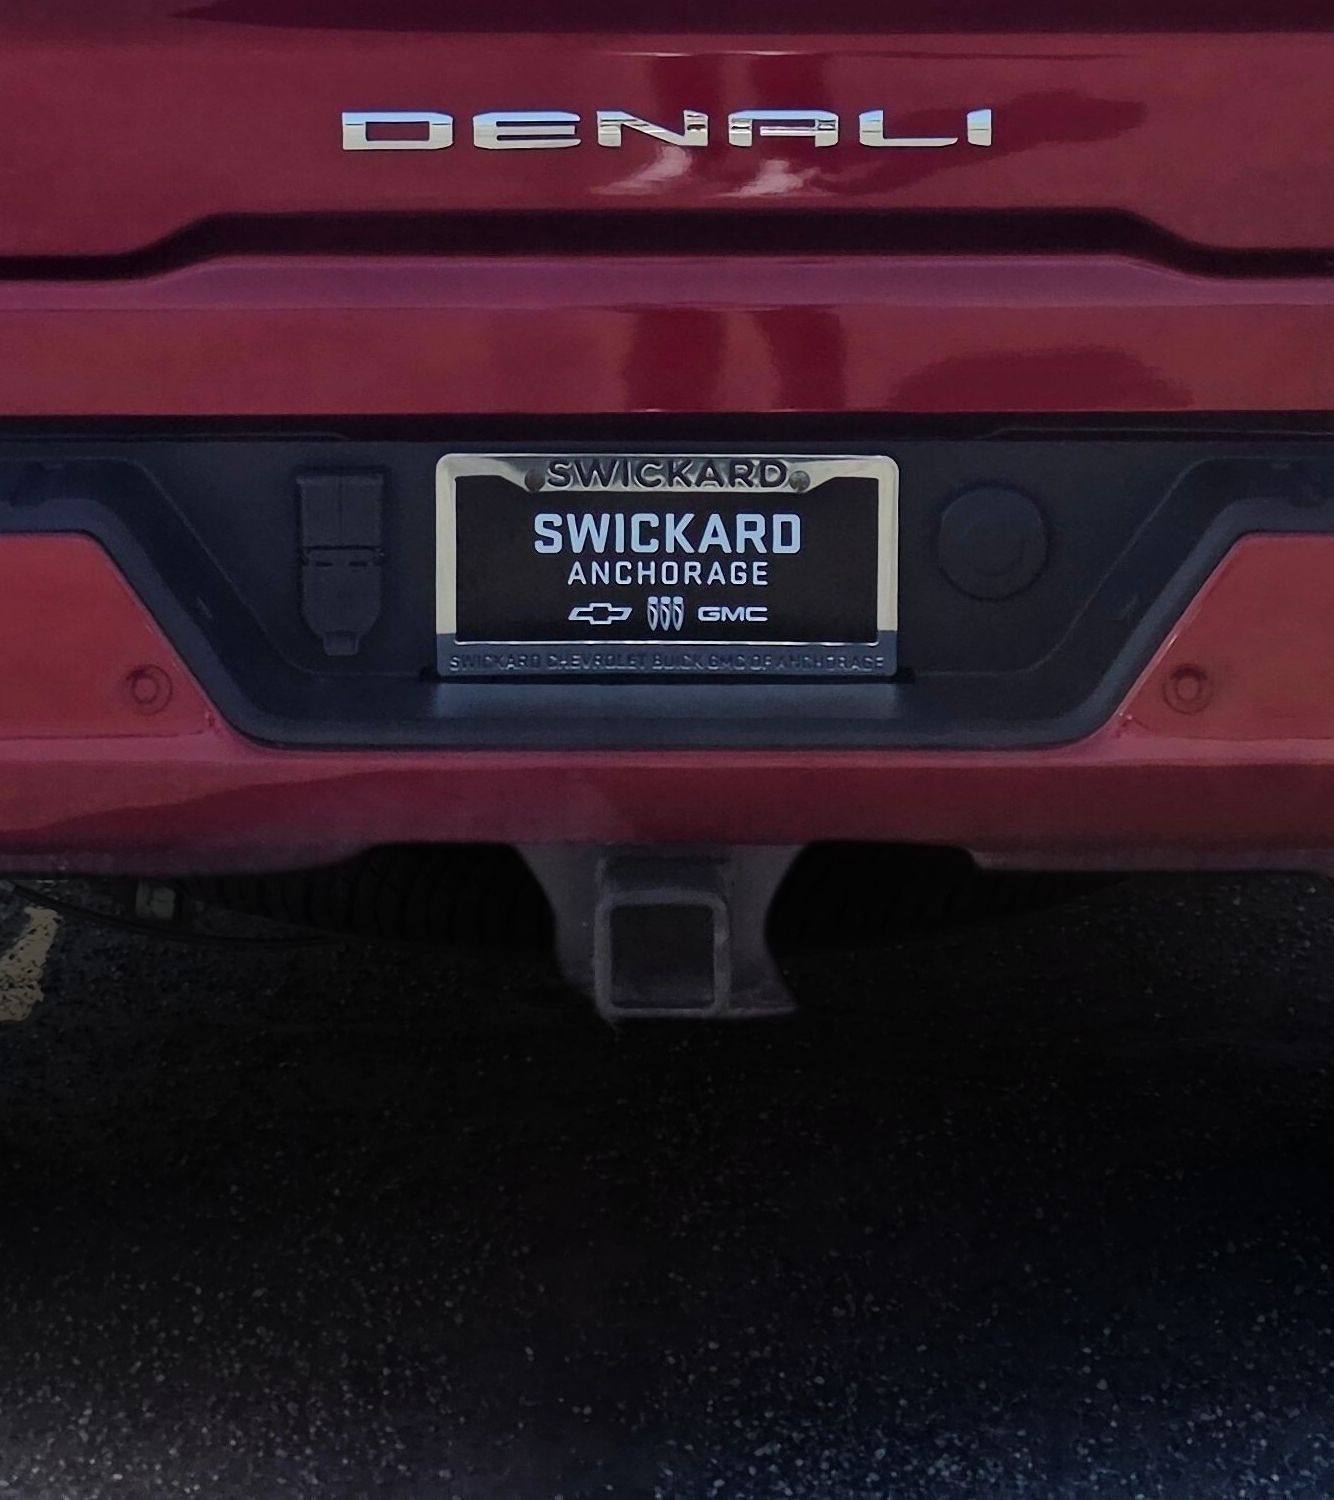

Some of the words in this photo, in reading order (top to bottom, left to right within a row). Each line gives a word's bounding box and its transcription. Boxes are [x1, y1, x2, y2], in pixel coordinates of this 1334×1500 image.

[341, 109, 993, 151] DENALI
[545, 458, 789, 490] SWICKARD
[533, 512, 802, 555] SWICKARD
[567, 560, 769, 587] ANCHORAGE
[696, 605, 769, 623] GMC
[450, 654, 542, 671] SWICKARD
[546, 654, 646, 671] CHEVROLET
